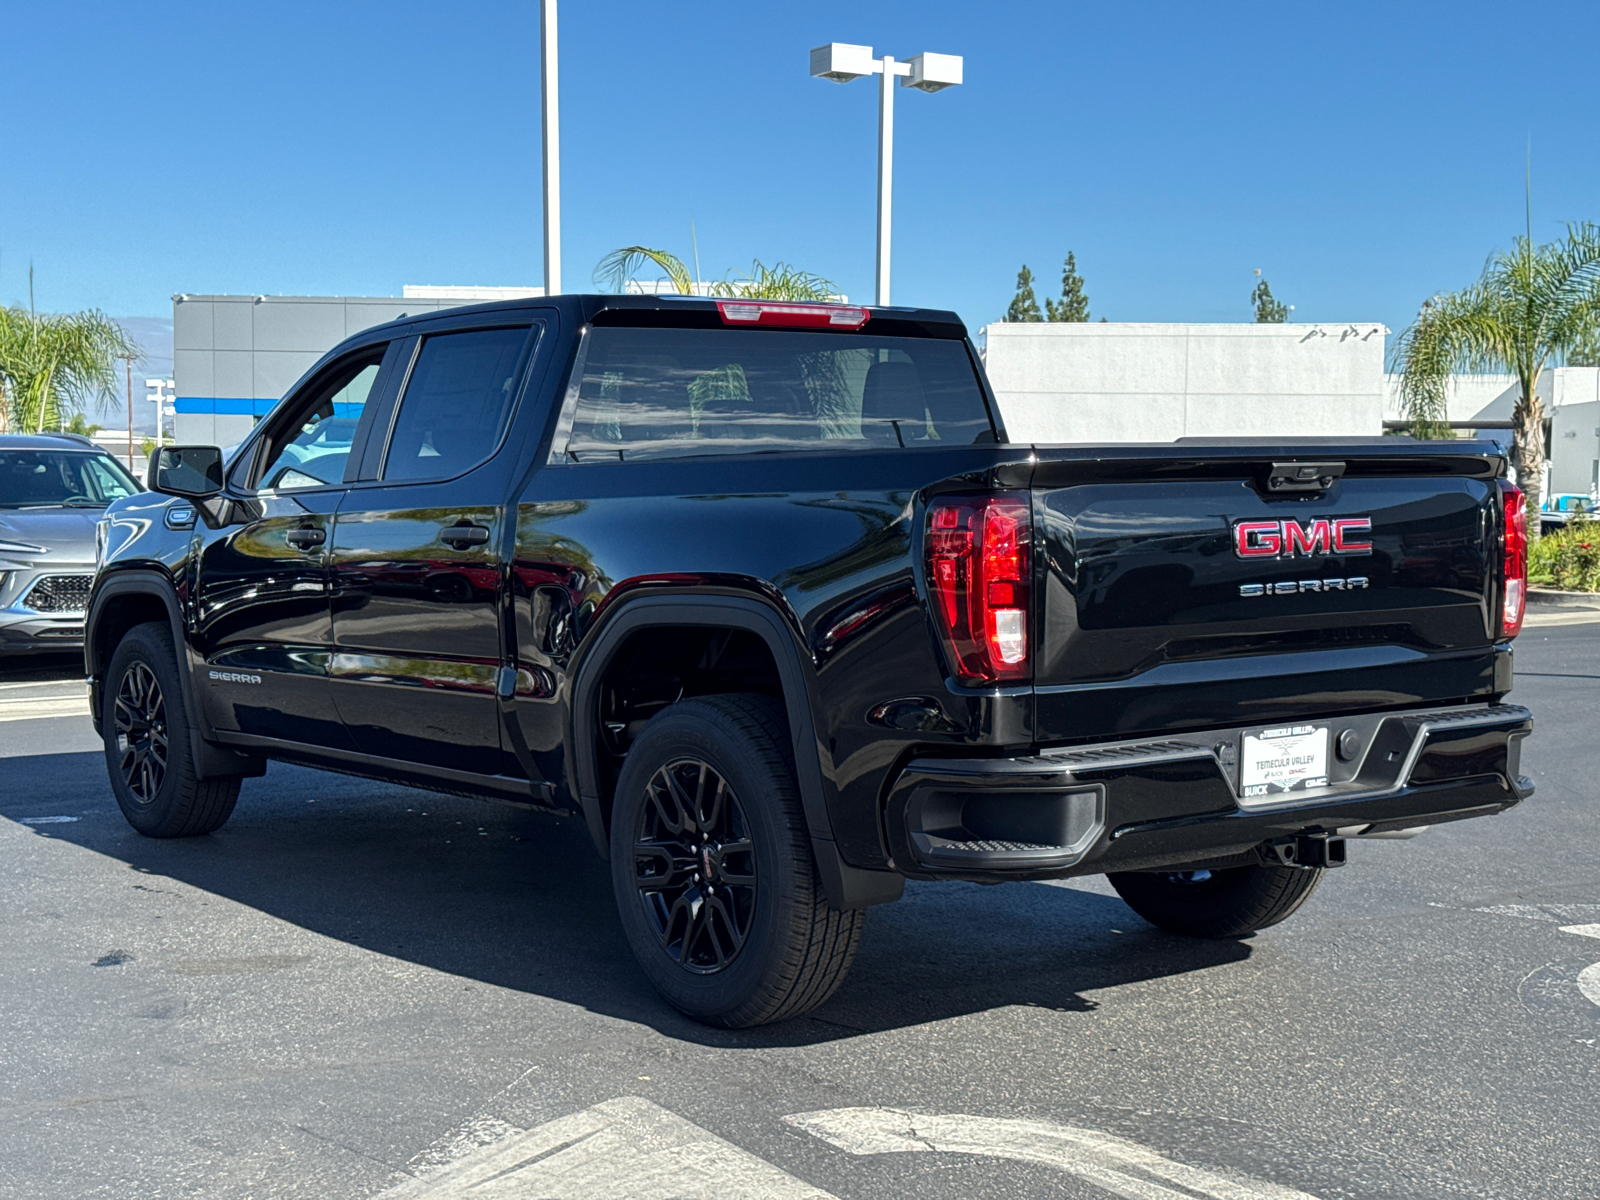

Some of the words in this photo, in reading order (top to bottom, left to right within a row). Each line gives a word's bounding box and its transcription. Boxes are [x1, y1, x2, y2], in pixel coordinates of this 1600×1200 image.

[1233, 516, 1373, 560] GMC
[1238, 576, 1370, 597] SIERRA
[208, 670, 262, 685] SIERRA
[1256, 758, 1290, 770] TEMECULA
[1292, 755, 1314, 766] VALLEY
[1305, 778, 1327, 788] GMC
[1244, 785, 1268, 797] BUICK
